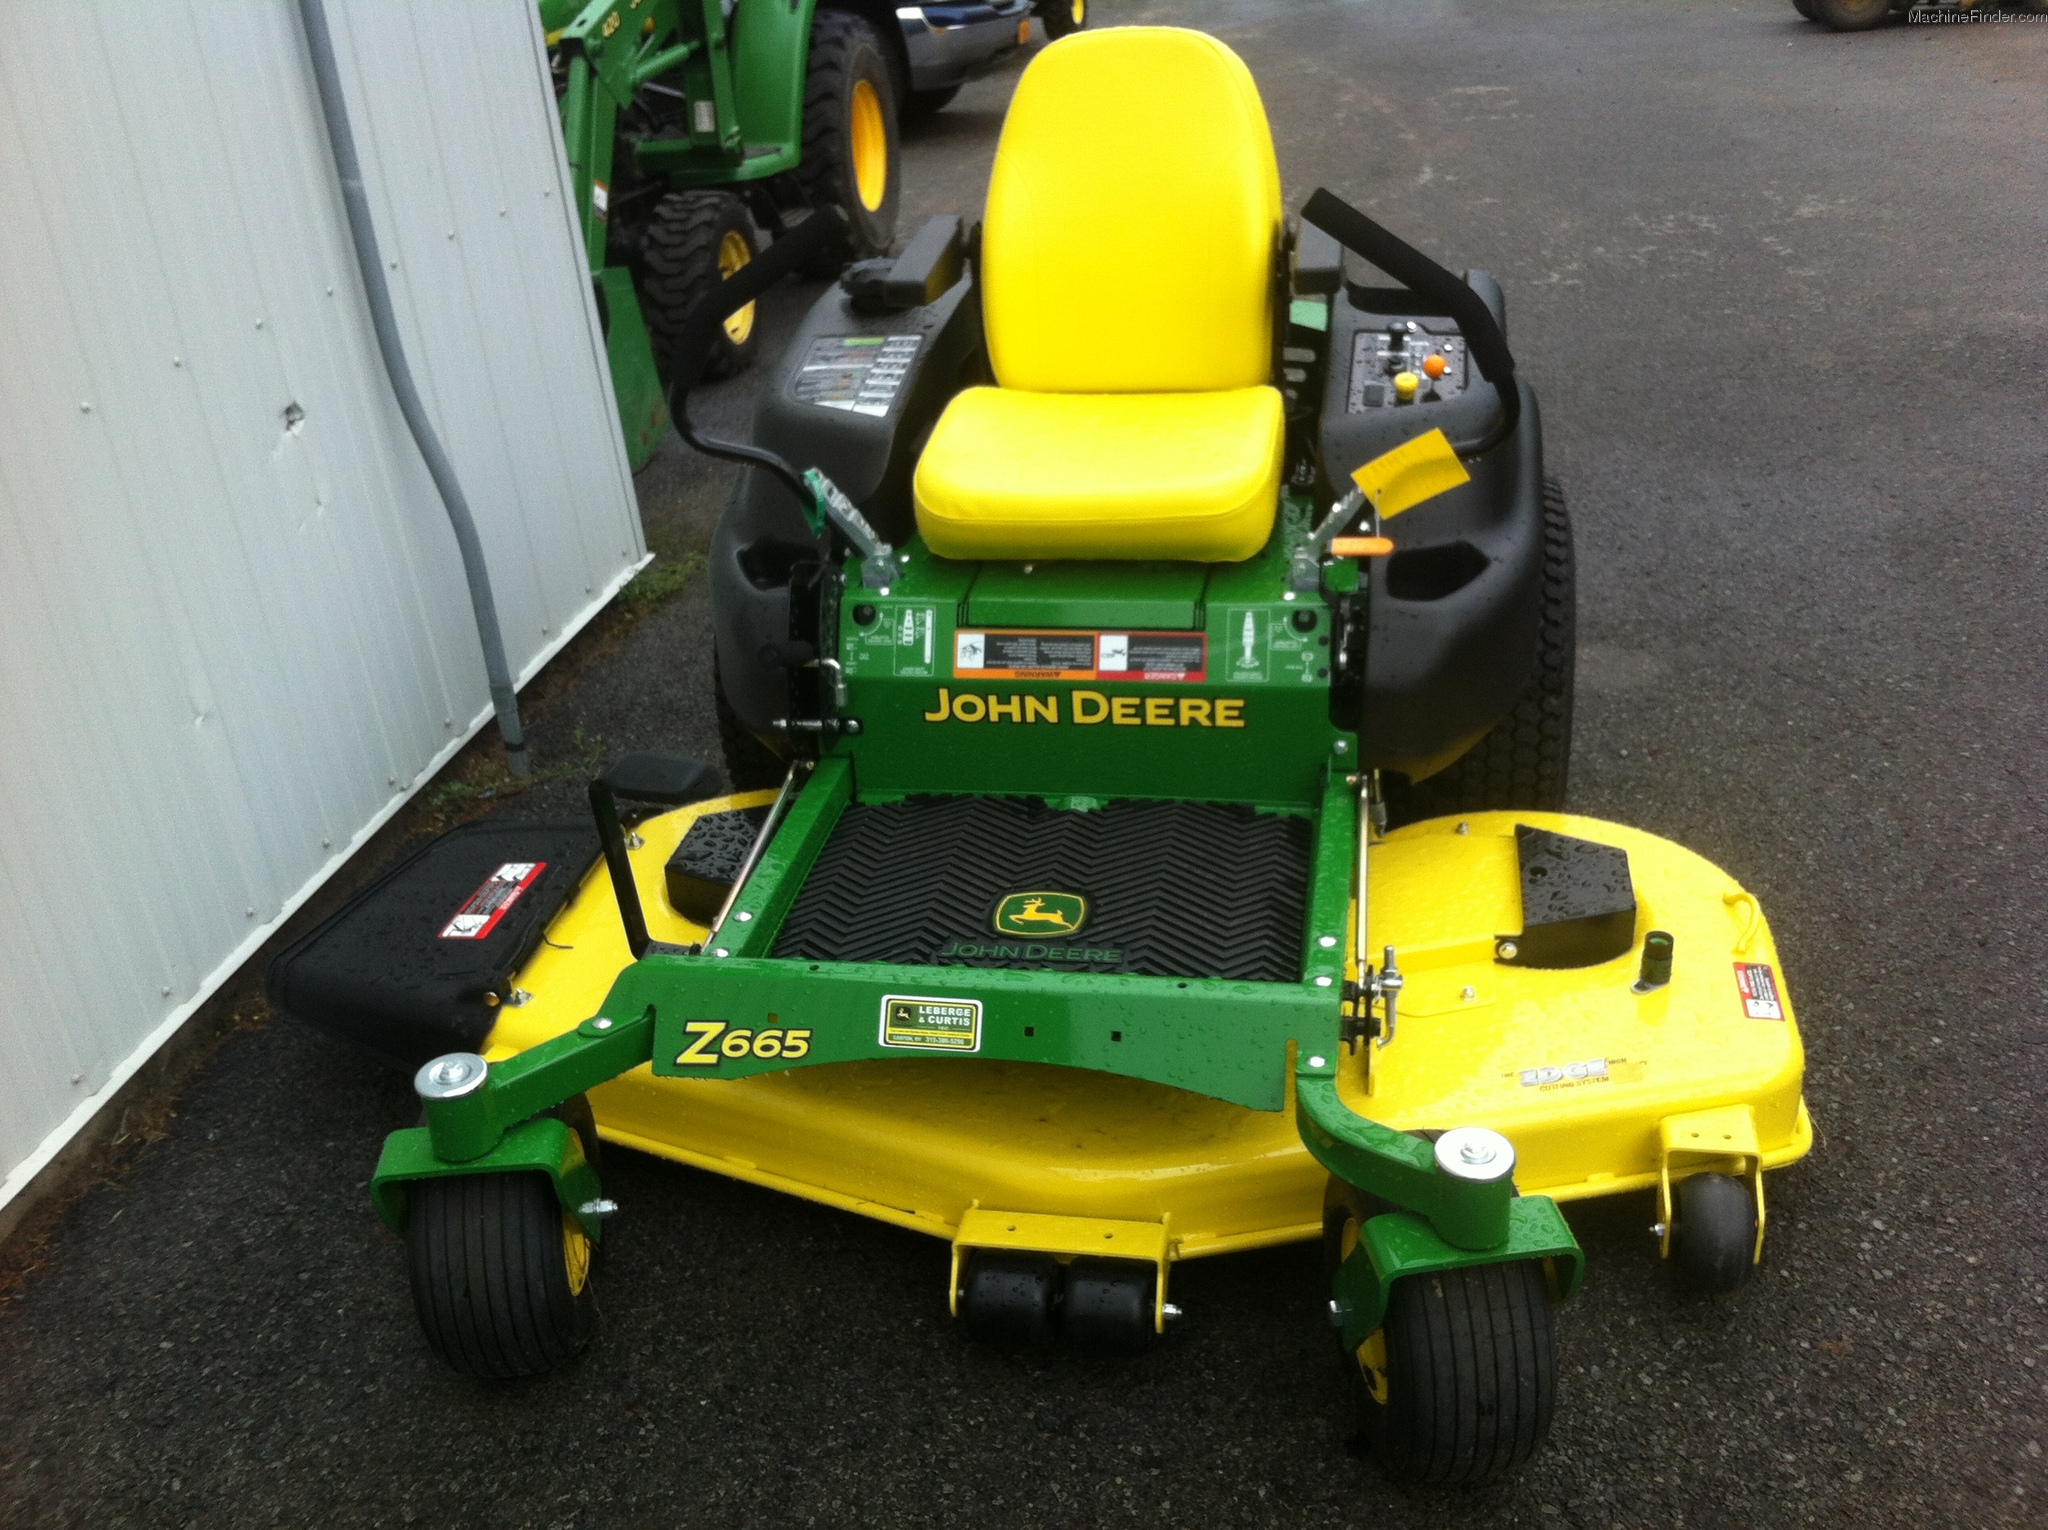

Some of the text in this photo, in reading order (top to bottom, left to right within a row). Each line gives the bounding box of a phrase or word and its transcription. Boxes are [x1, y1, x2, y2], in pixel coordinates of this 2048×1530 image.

[924, 687, 1245, 727] JOHN DEERE
[940, 942, 1121, 962] JOHN DEERE
[919, 1006, 971, 1017] LEBERGE
[928, 1016, 970, 1026] CURTIS
[675, 1022, 811, 1064] Z665
[1577, 1076, 1609, 1087] SYSTEM
